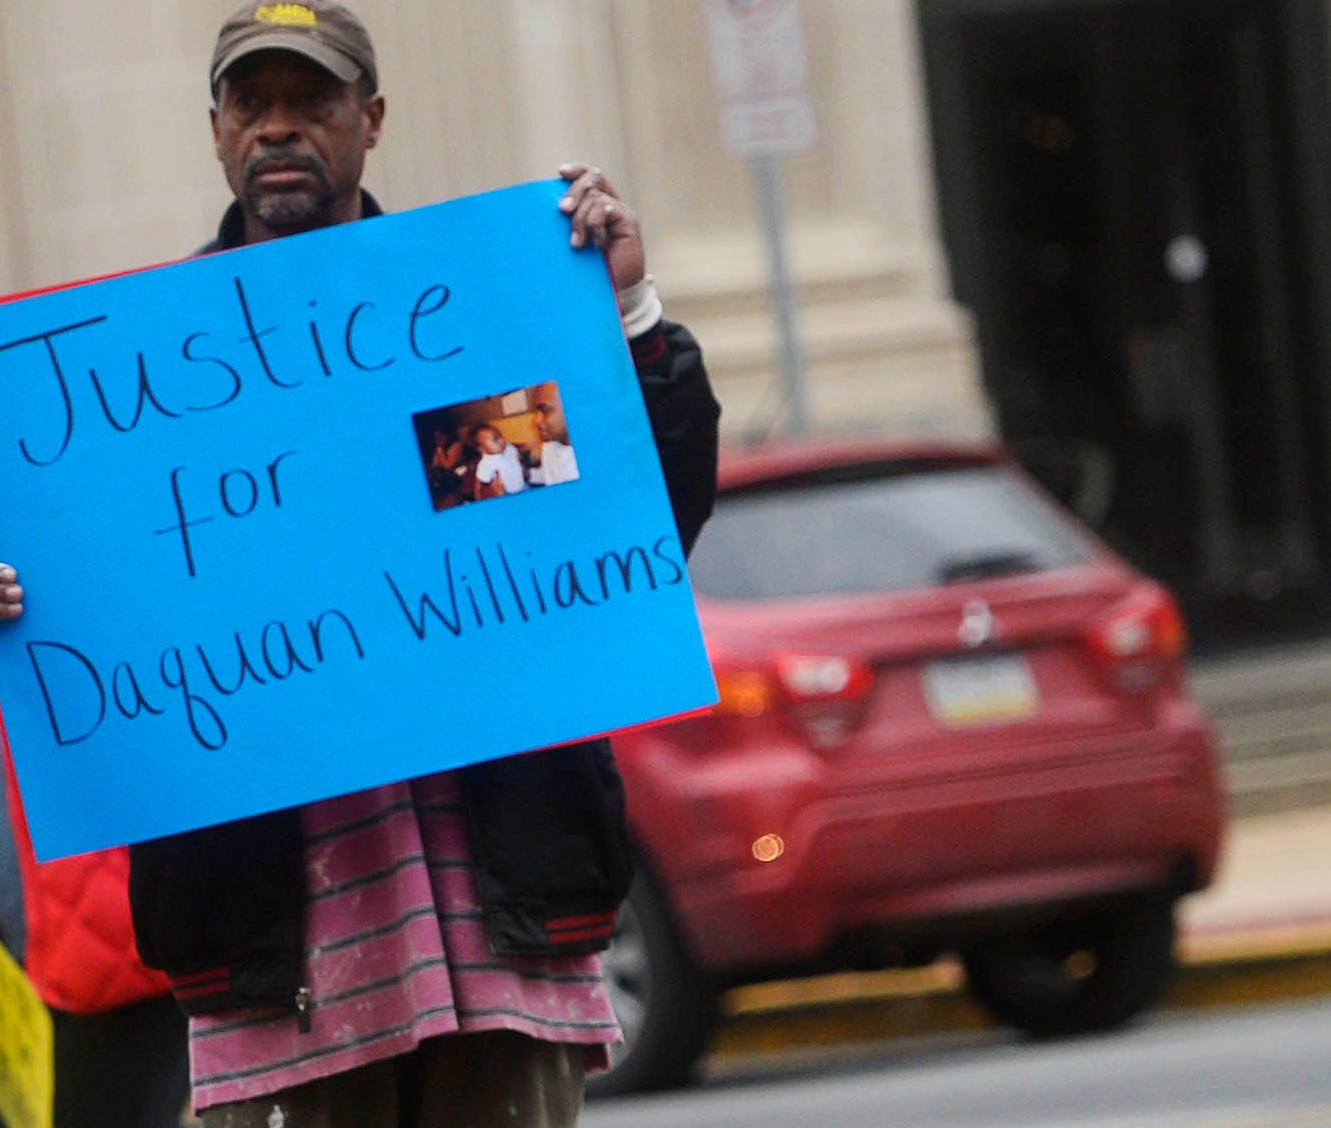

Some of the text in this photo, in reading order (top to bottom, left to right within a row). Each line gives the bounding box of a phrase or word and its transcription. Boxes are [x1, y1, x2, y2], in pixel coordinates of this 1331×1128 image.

[155, 450, 299, 578] for
[26, 534, 684, 752] Daquan Williams
